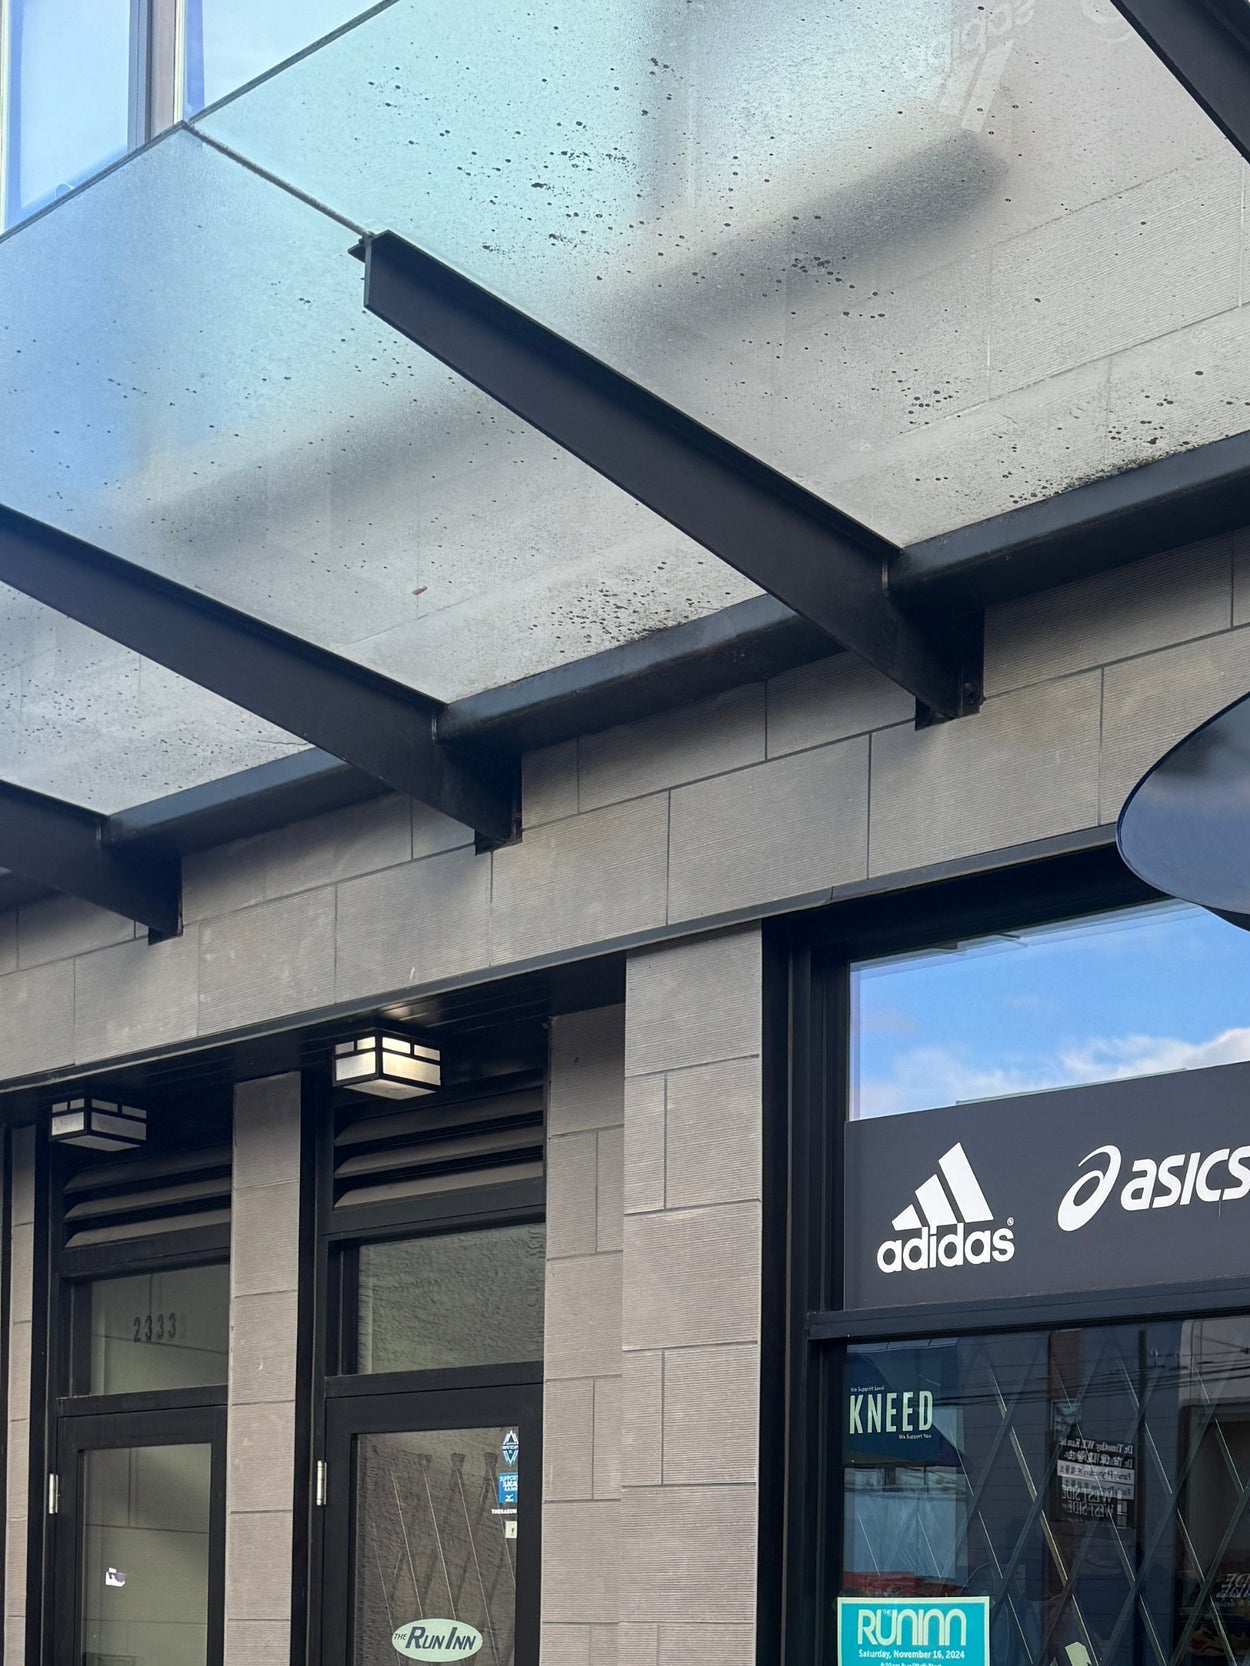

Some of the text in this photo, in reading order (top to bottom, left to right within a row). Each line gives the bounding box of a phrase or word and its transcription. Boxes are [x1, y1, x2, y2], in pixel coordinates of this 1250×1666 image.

[876, 1223, 1016, 1274] adidas
[133, 1312, 177, 1343] 2333
[849, 1390, 933, 1434] KNEED
[858, 1649, 892, 1660] Saturday,
[894, 1650, 931, 1659] November
[946, 1650, 965, 1659] 2024
